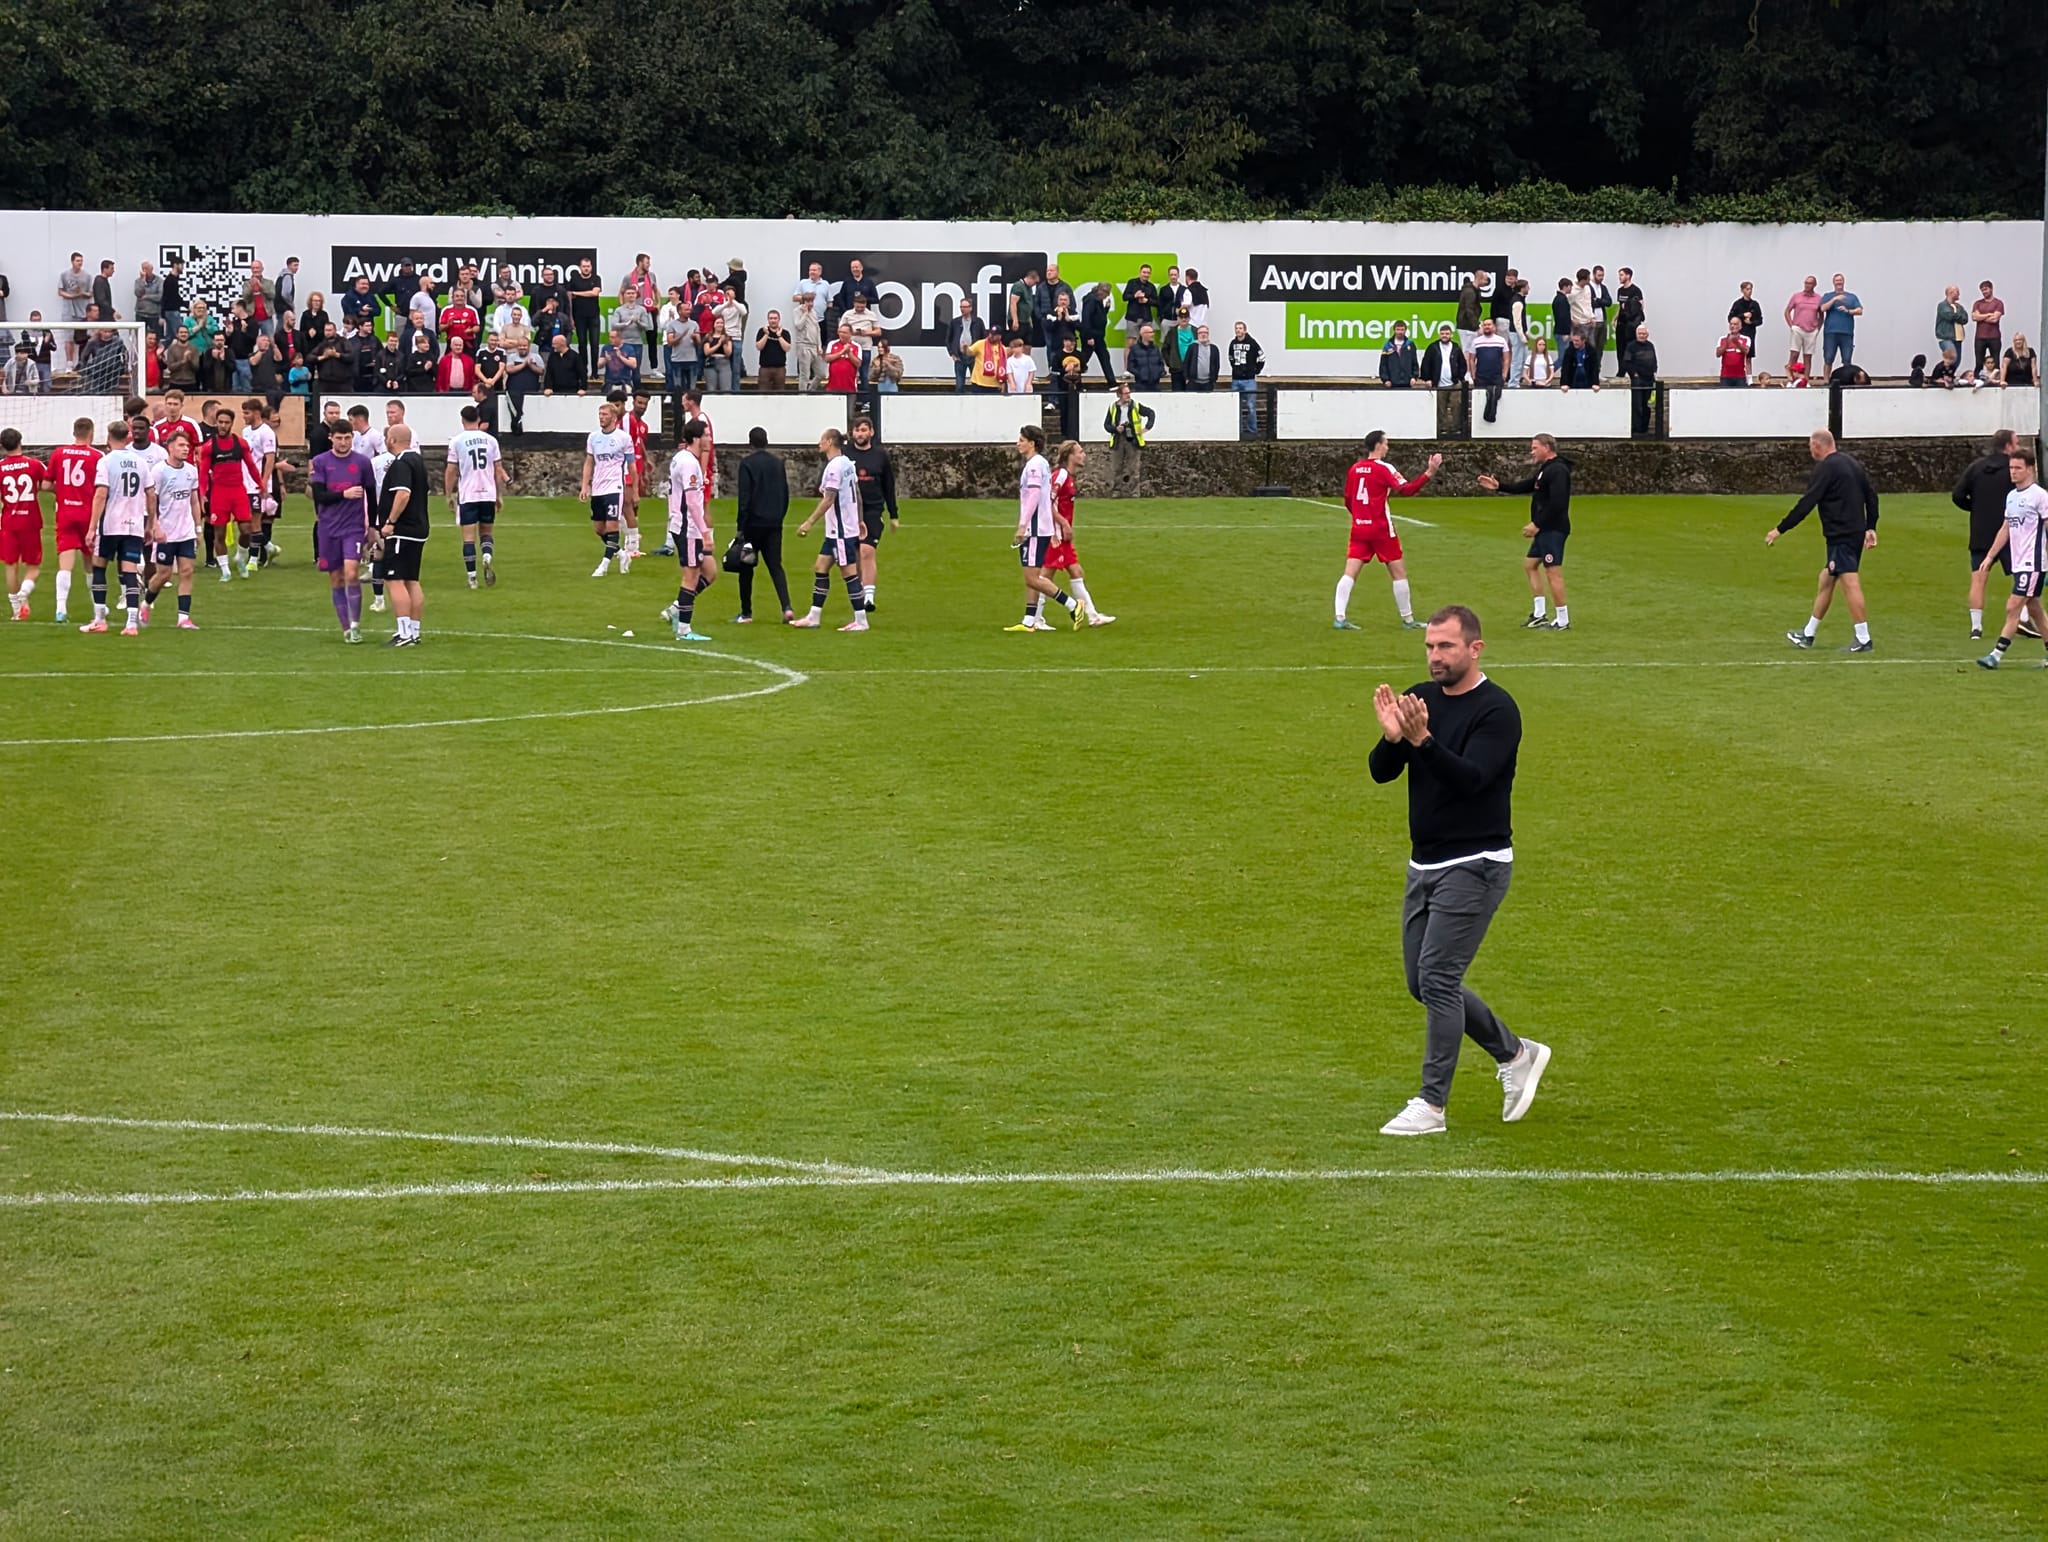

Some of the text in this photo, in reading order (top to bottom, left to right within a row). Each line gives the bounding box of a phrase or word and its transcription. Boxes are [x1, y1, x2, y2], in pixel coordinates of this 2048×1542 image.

[1260, 264, 1496, 298] Award Winning
[468, 447, 487, 470] 15
[62, 459, 86, 488] 16
[121, 472, 140, 497] 19
[2, 474, 35, 504] 32
[252, 496, 260, 506] 2
[1356, 477, 1369, 505] 4
[2019, 574, 2028, 587] 9
